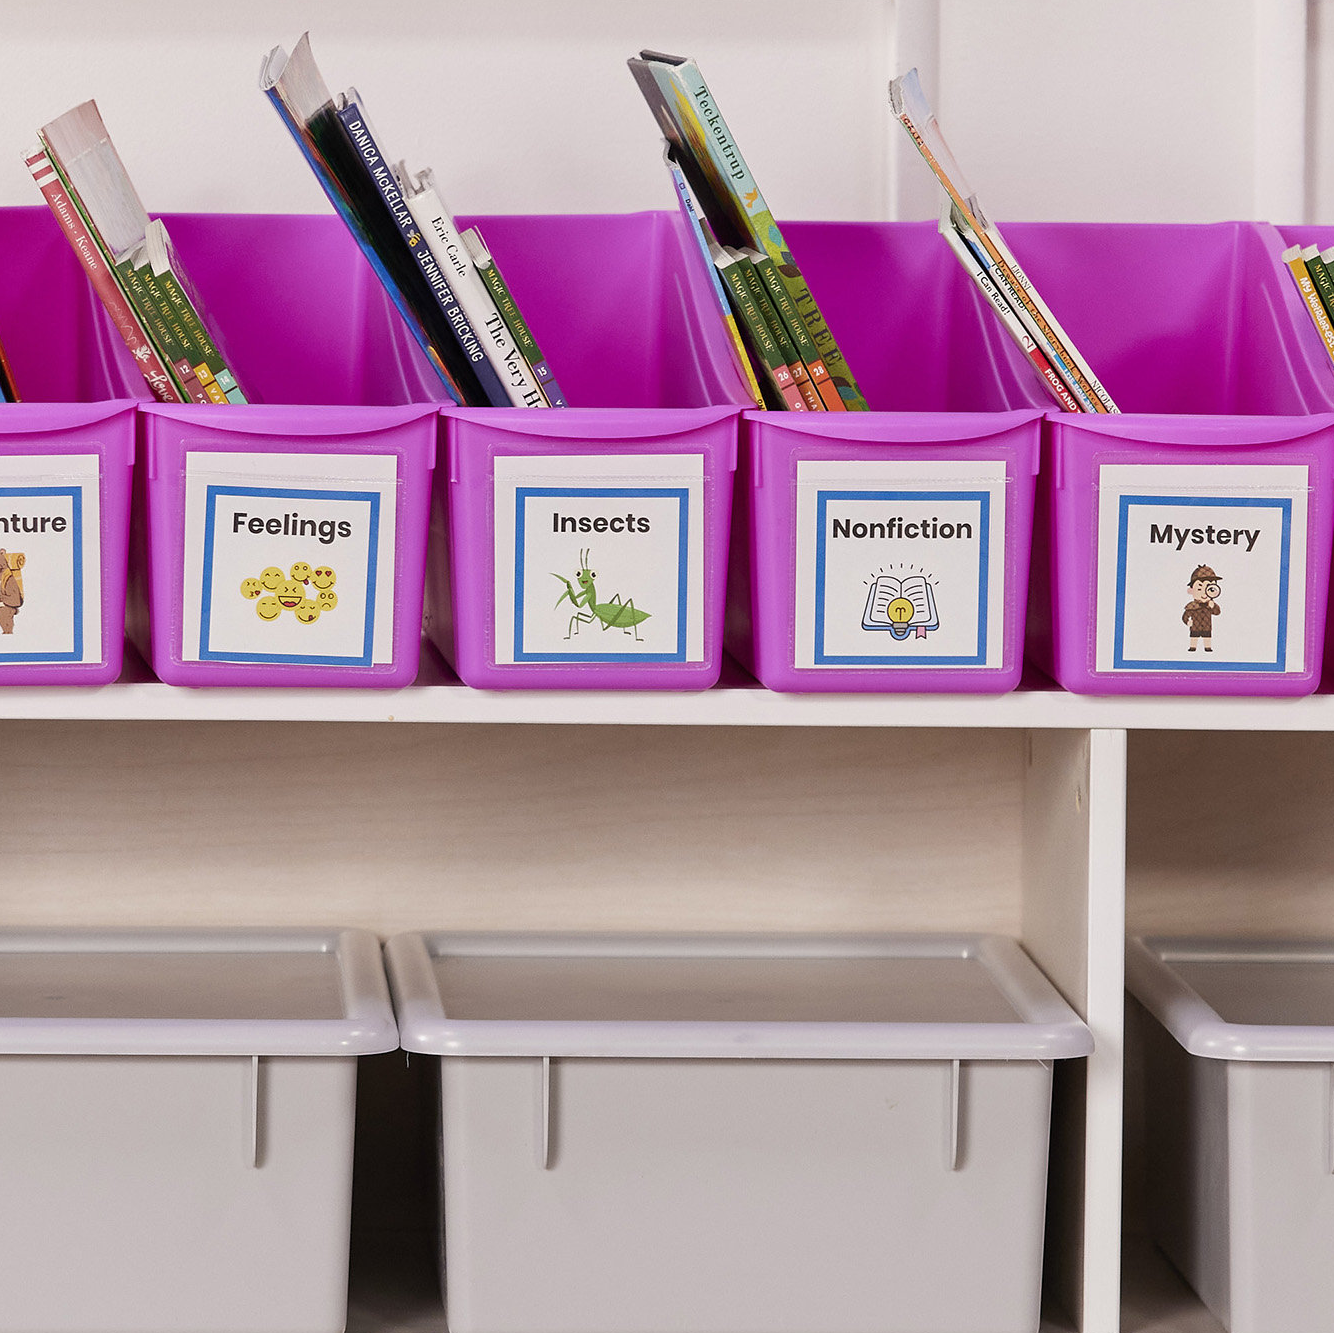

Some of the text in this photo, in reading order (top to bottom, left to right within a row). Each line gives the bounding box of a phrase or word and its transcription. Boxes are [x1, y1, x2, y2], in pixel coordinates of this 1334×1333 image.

[693, 86, 746, 180] Teckentrup
[51, 193, 98, 269] Adams Keane
[349, 120, 379, 166] DANICA
[417, 249, 454, 306] JENNIFER
[447, 306, 484, 362] BRICKING
[431, 216, 466, 278] Eric Carle
[1011, 264, 1031, 290] LIONNI
[1300, 277, 1312, 292] My
[980, 276, 993, 293] Can
[991, 292, 1010, 315] Read!
[793, 287, 842, 367] TREE
[179, 365, 190, 374] 12
[484, 312, 543, 407] The Very H
[537, 367, 547, 377] 15
[793, 367, 803, 377] 27
[813, 366, 824, 376] 28
[198, 369, 208, 379] 13
[777, 371, 789, 381] 26
[1044, 368, 1064, 392] FROG
[1061, 392, 1077, 410] AND
[232, 512, 352, 541] Feelings
[552, 512, 651, 533] Insects
[831, 516, 973, 540] Nonfiction
[1150, 523, 1261, 553] Mystery
